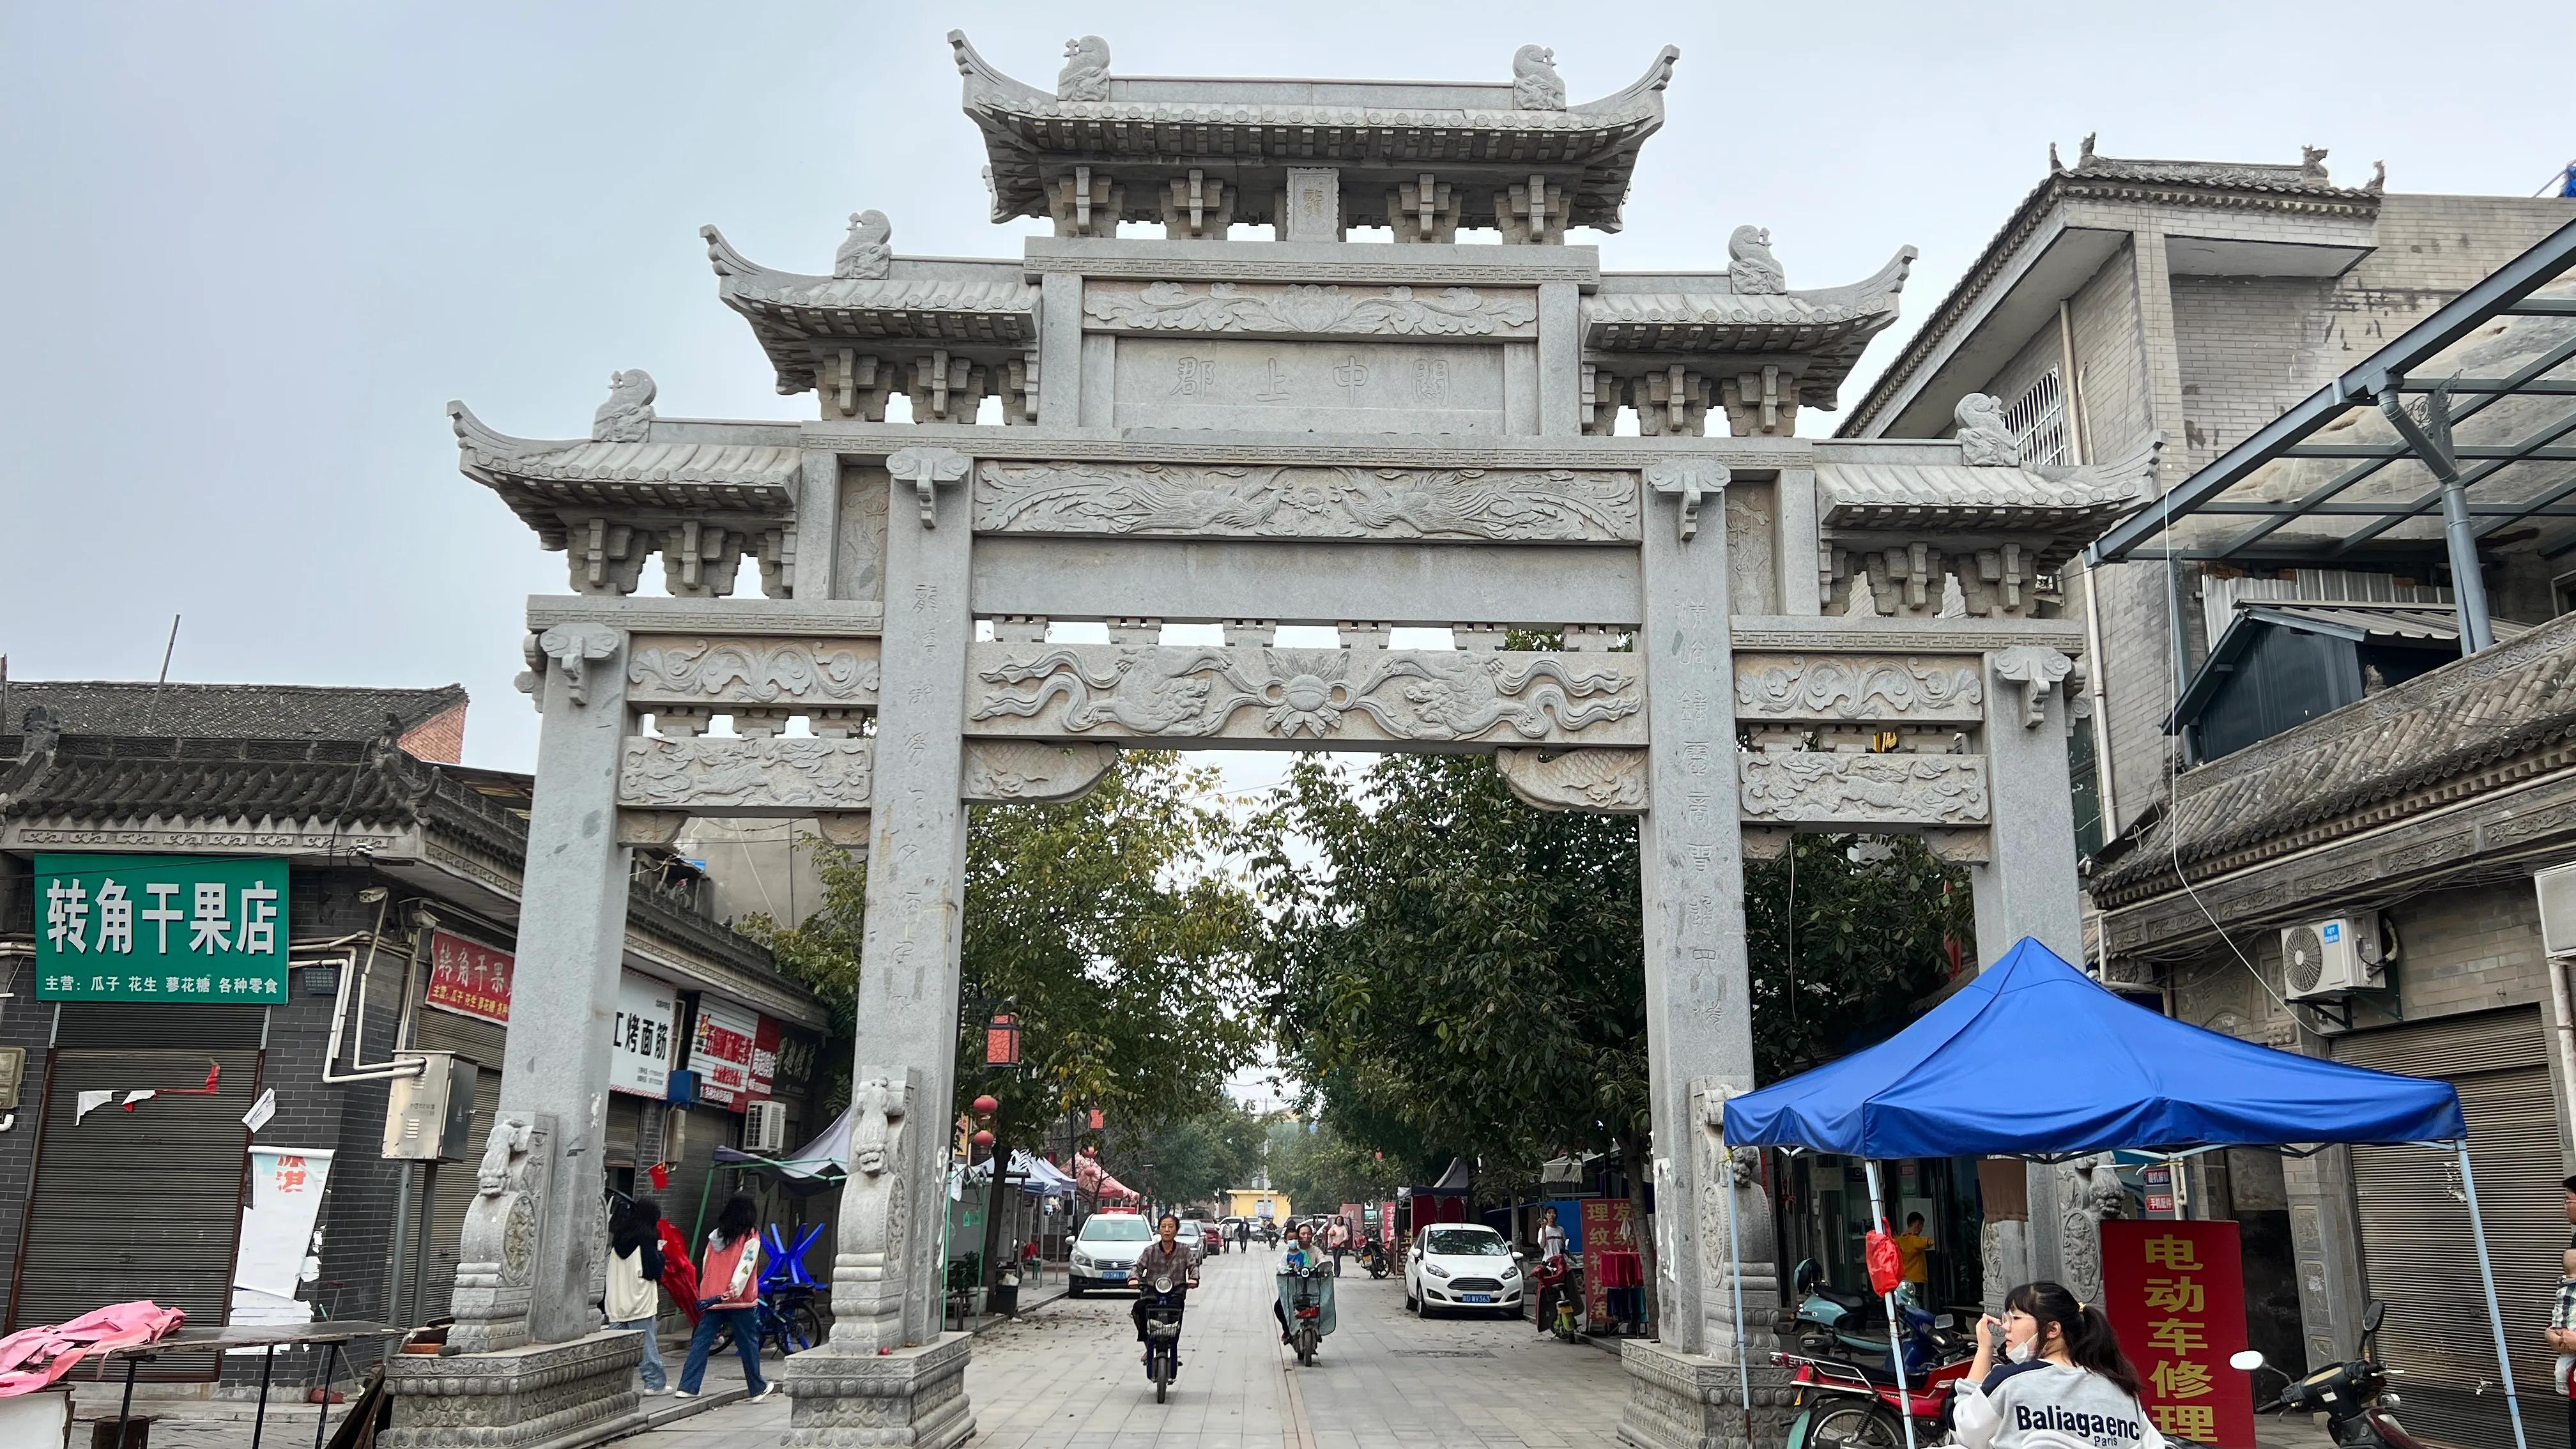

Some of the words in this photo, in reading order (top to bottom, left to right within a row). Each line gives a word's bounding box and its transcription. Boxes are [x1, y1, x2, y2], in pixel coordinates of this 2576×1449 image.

[47, 877, 278, 954] 转角干果店
[91, 976, 120, 992] 瓜子
[128, 976, 157, 992] 花生
[218, 977, 278, 993] 各种零食
[438, 942, 511, 997] 转角干果
[2150, 1197, 2172, 1209] 手机配件
[2143, 1234, 2218, 1443] 电动车修理
[2094, 1436, 2118, 1447] Paris
